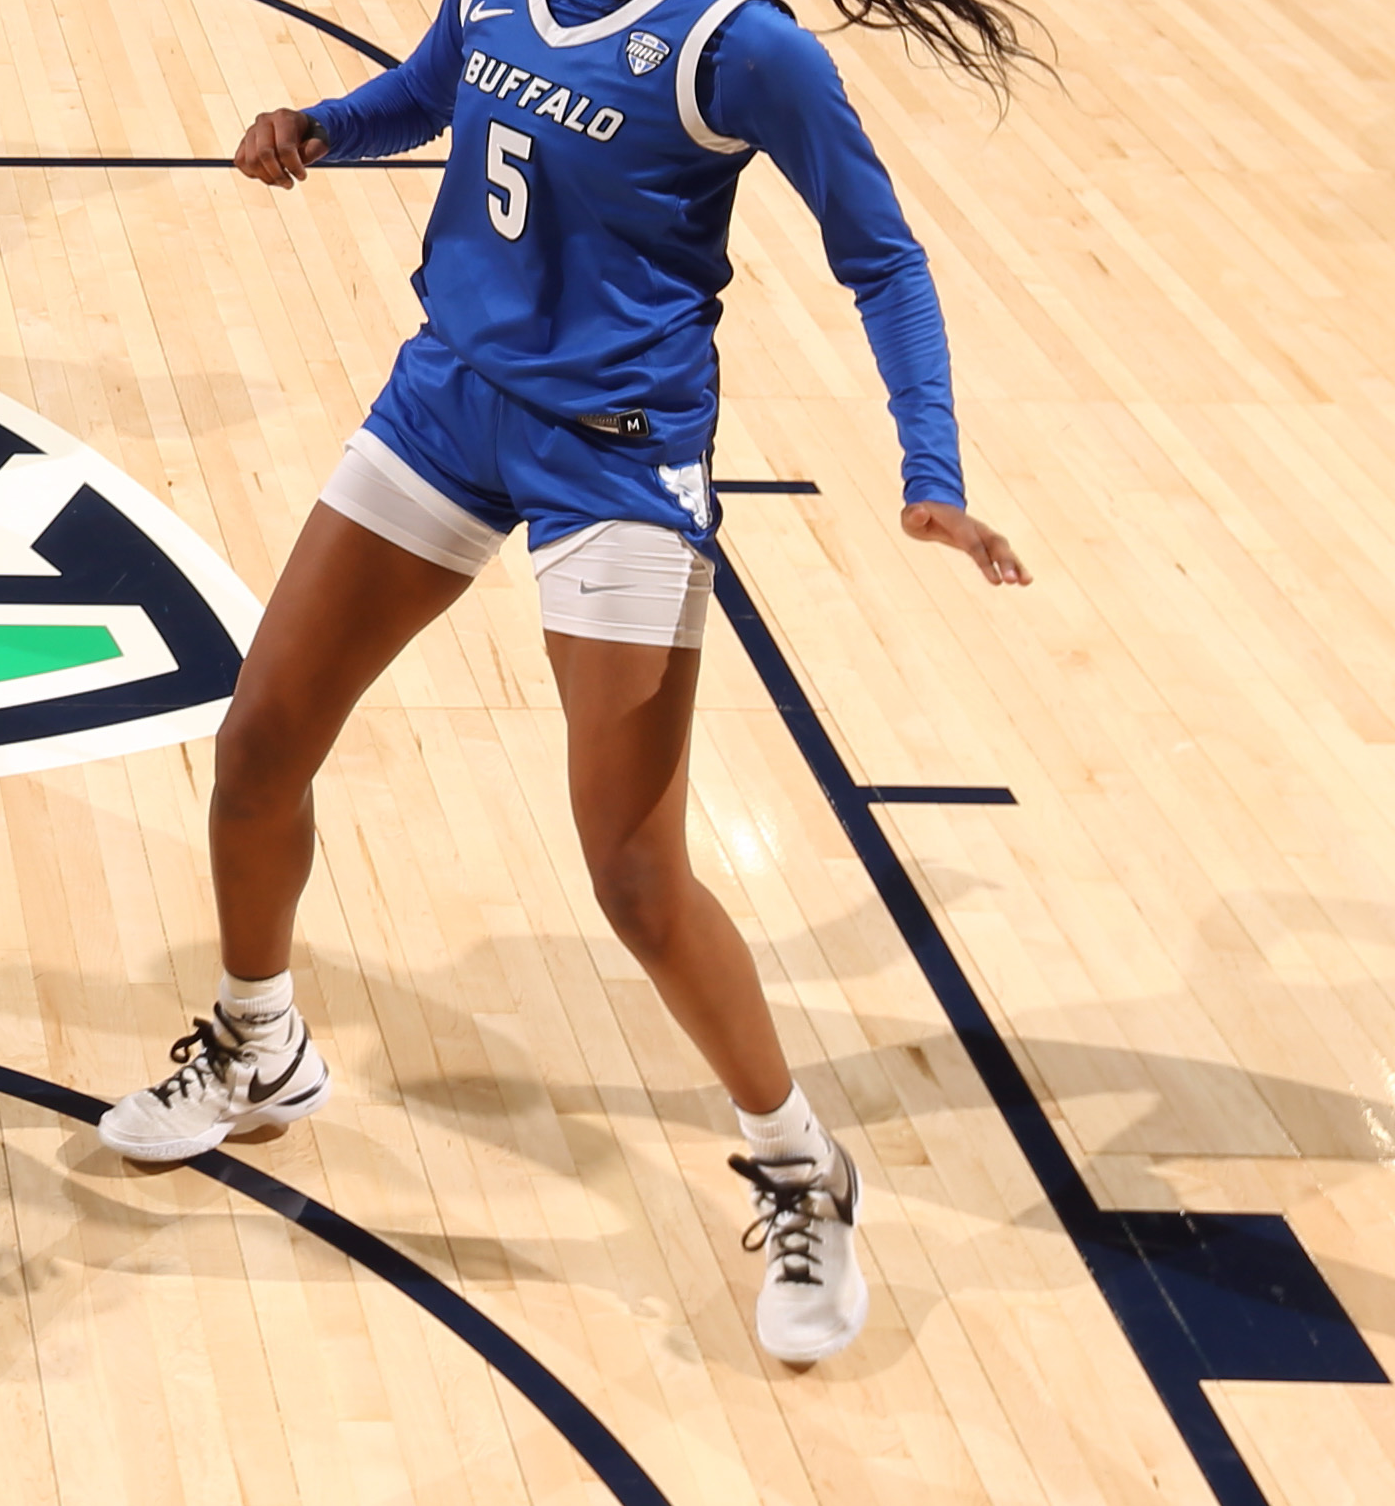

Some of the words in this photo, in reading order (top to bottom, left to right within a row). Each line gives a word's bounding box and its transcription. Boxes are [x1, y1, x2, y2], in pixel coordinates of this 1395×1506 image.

[625, 40, 665, 65] MAC
[463, 48, 626, 143] BUFFALO
[486, 120, 535, 242] 5
[627, 417, 640, 432] M
